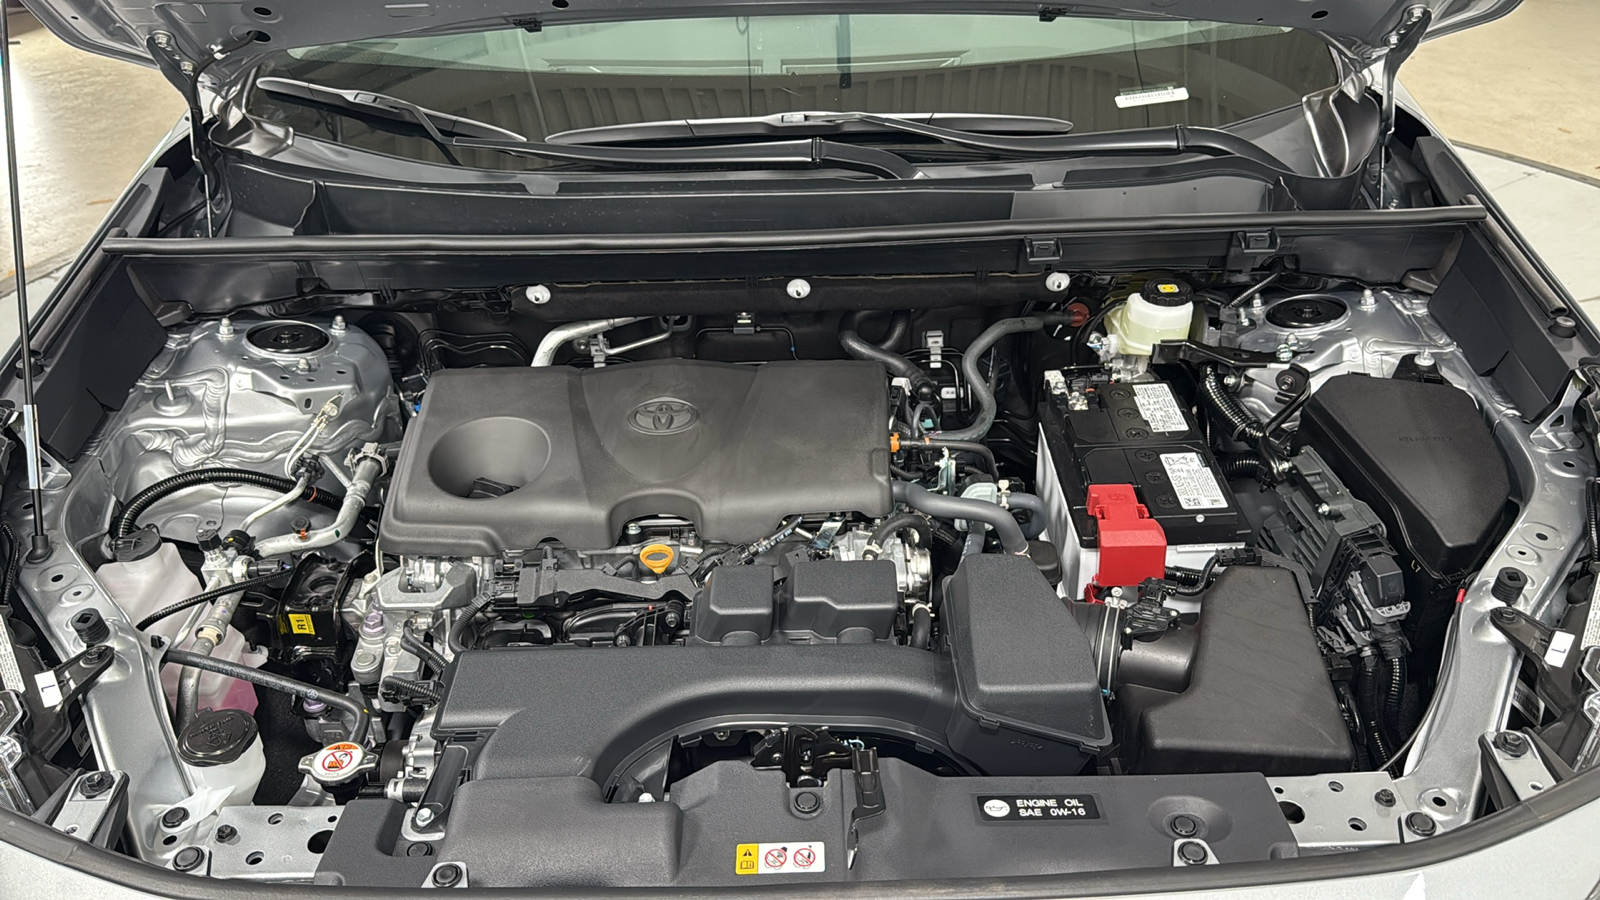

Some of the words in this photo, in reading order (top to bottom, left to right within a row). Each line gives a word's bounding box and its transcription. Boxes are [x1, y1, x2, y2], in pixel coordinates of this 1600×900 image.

[296, 619, 307, 630] R1
[1016, 799, 1058, 807] ENGINE
[1064, 798, 1084, 807] OIL
[1019, 808, 1043, 817] SAE
[1050, 807, 1086, 816] 0W-16
